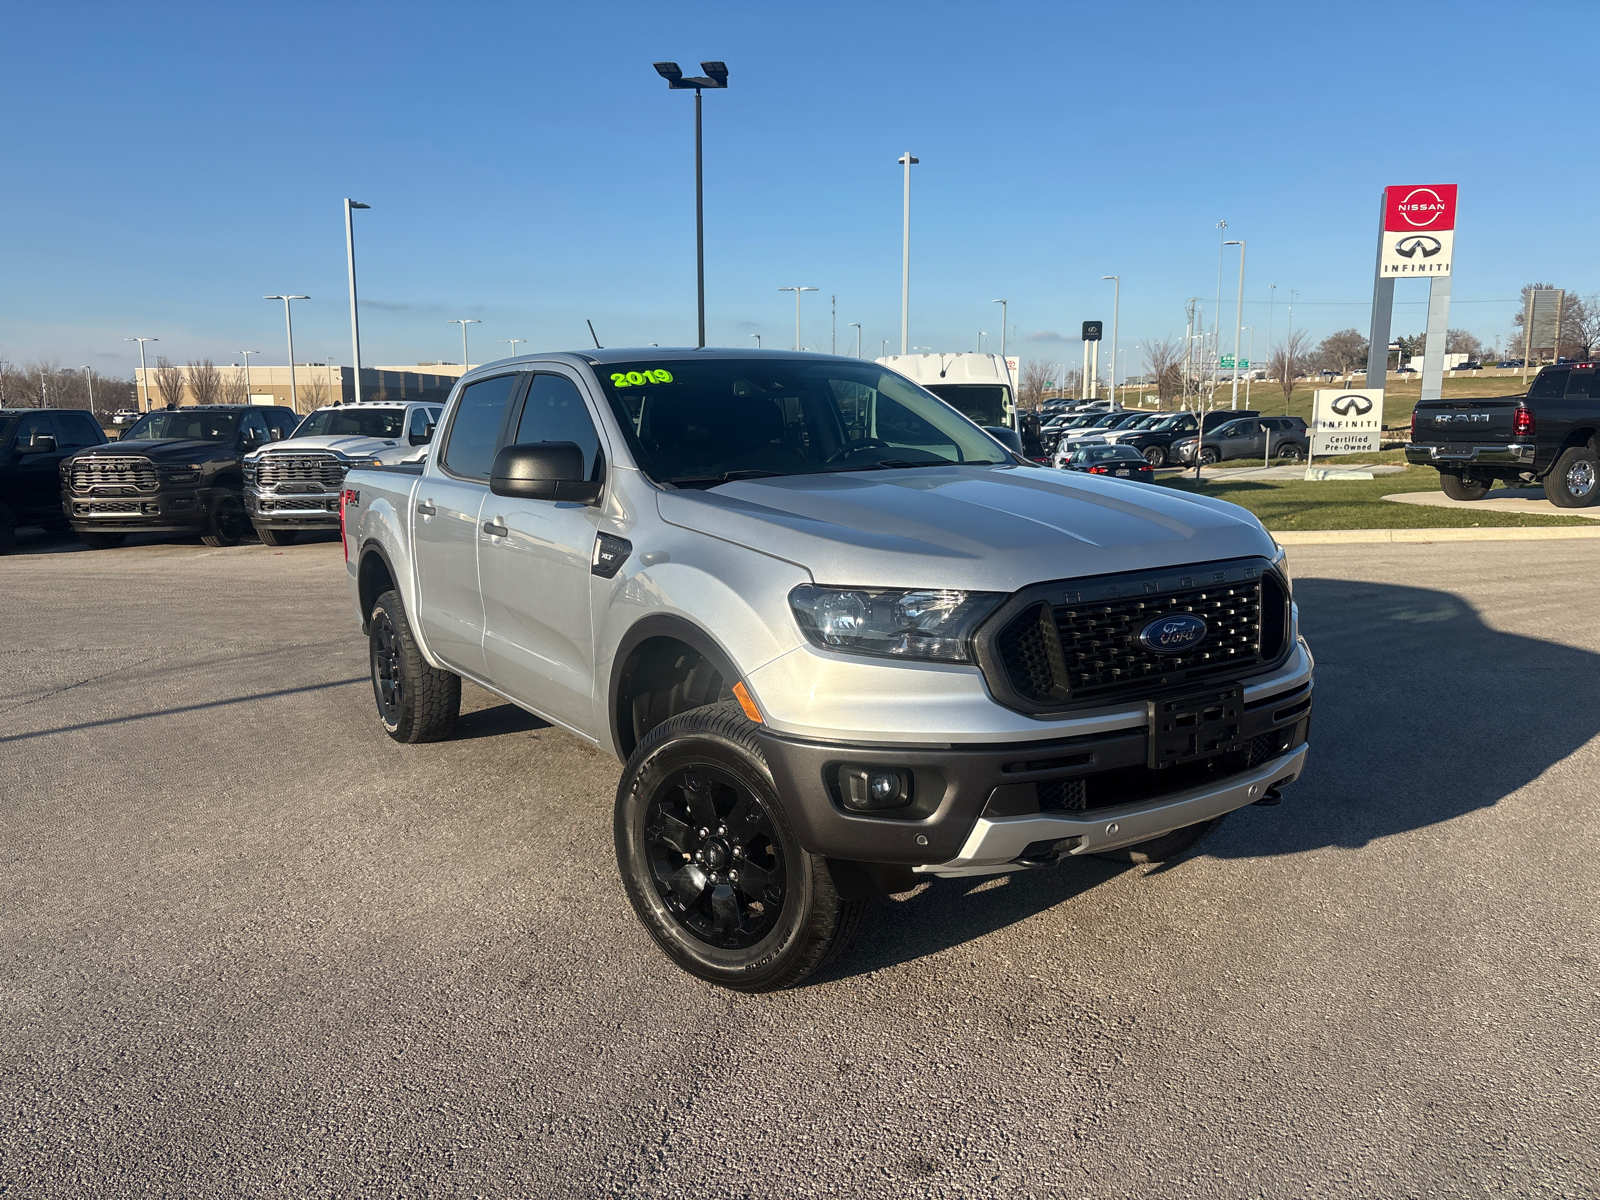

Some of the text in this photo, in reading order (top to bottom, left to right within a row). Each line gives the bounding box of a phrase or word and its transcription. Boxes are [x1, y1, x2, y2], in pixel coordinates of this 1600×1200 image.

[1398, 203, 1445, 211] NISSAN
[1384, 263, 1449, 272] INFINITI
[610, 369, 674, 388] 2019
[1435, 413, 1490, 423] RAM
[1322, 420, 1378, 428] INFINITI
[1330, 435, 1368, 443] Certified
[1325, 443, 1372, 451] Pre-Owned
[89, 464, 131, 472] RAM
[345, 489, 360, 505] FX4
[601, 552, 614, 561] XLT
[1062, 567, 1258, 603] RANGER
[1160, 621, 1196, 645] Ford
